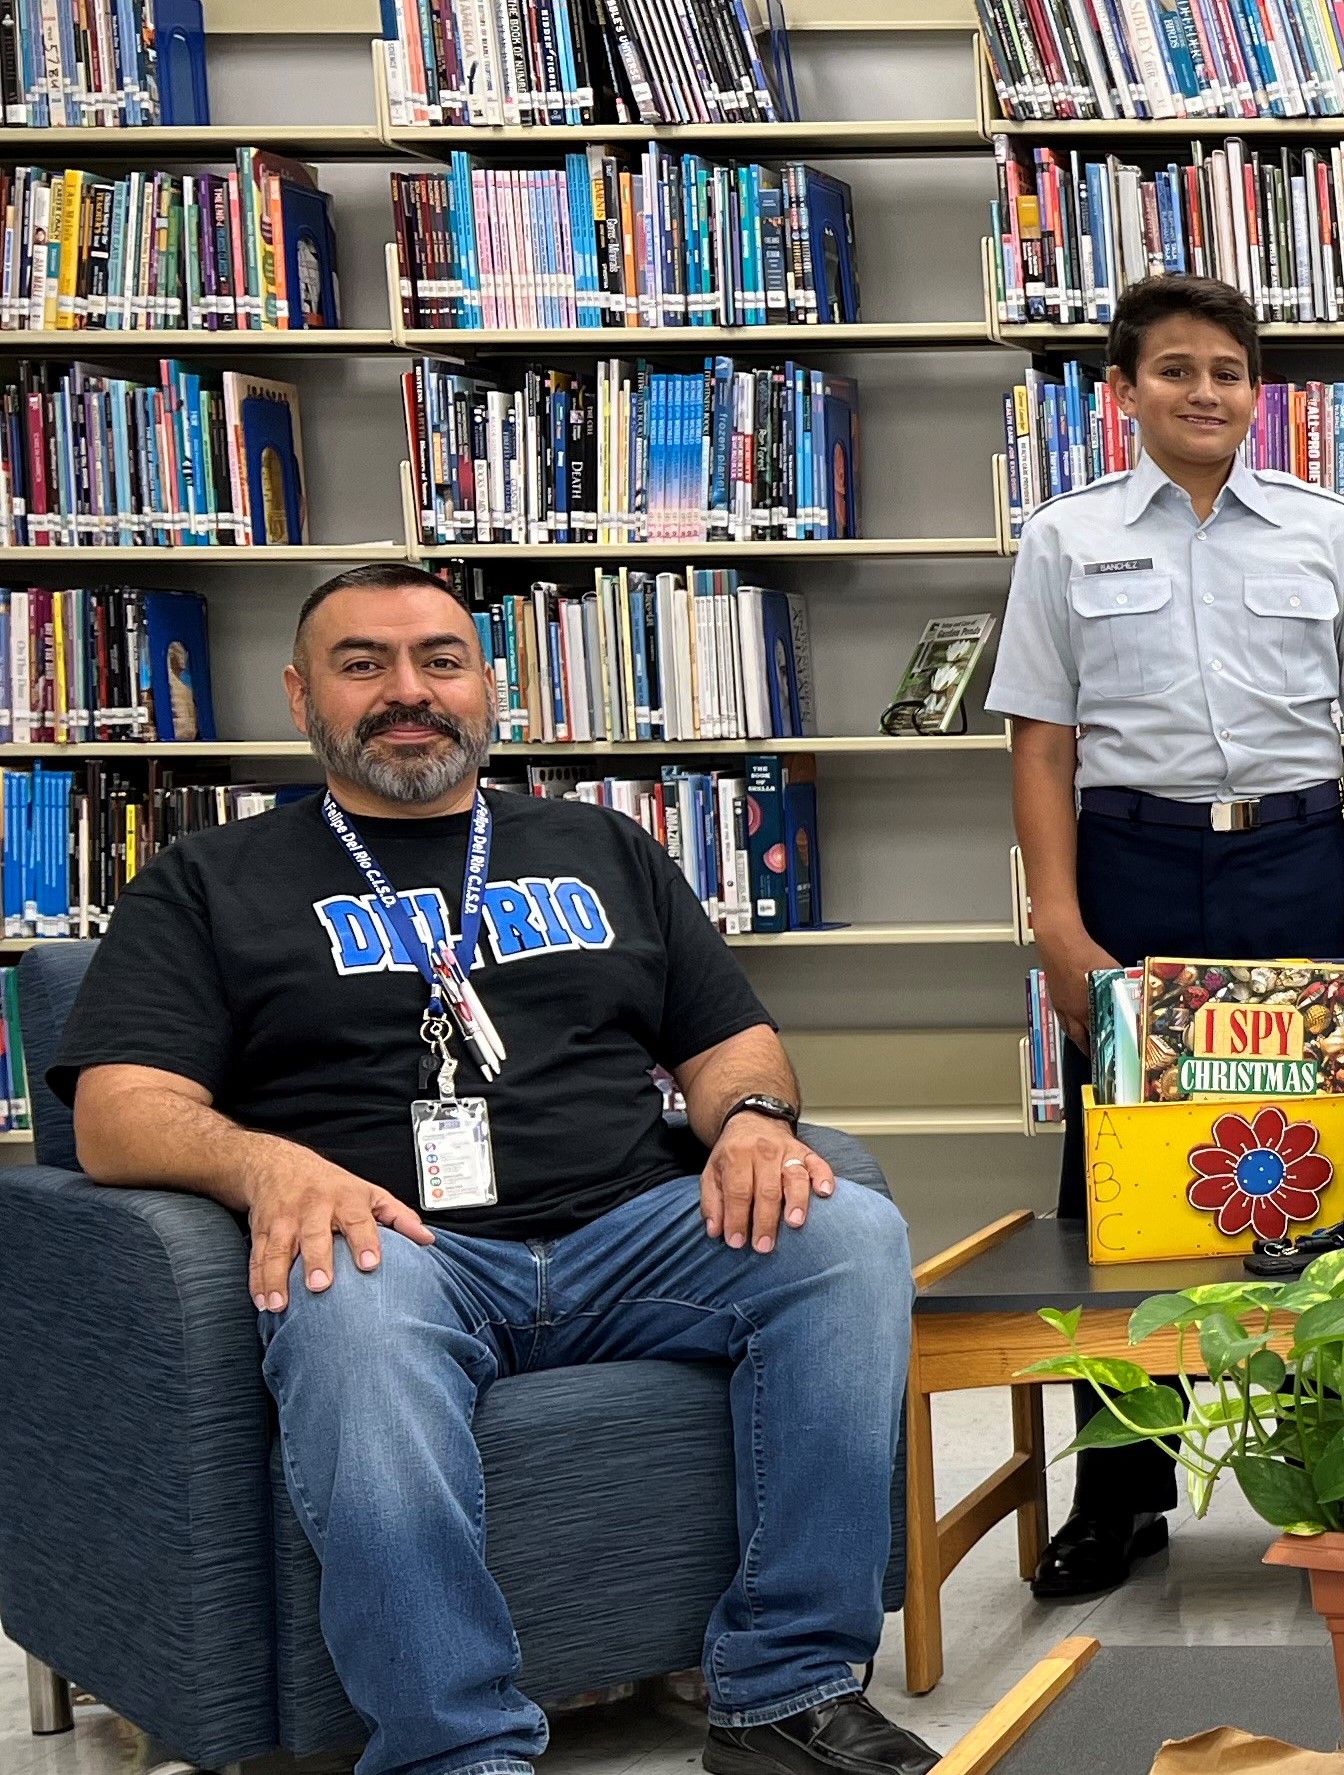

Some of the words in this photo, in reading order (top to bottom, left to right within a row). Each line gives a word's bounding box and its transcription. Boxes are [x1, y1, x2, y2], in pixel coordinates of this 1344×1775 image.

[460, 5, 477, 58] AMERICA
[509, 19, 522, 44] BOOK
[541, 9, 553, 49] HIDDEN
[1129, 2, 1156, 54] SIBLEY
[1164, 19, 1180, 49] BIRDS
[46, 45, 59, 64] 57
[513, 47, 522, 58] OF
[48, 69, 60, 89] BU
[545, 54, 557, 92] FIGURE
[66, 191, 75, 208] Am
[63, 210, 75, 241] Malala
[113, 213, 122, 234] AFTER
[1005, 399, 1013, 425] HEALTH
[716, 413, 729, 452] frozen
[1307, 406, 1320, 460] ALL-PRO
[716, 454, 729, 492] planet
[758, 446, 767, 471] Forest
[1049, 452, 1058, 486] Therapists
[1307, 462, 1320, 487] DIET
[571, 461, 583, 499] DEATH
[1100, 561, 1138, 572] SANCHEZ
[17, 641, 26, 655] On
[17, 658, 26, 675] This
[471, 834, 488, 853] Del
[665, 807, 679, 858] AMAZING
[325, 801, 348, 834] Felipe
[341, 832, 363, 852] Del
[352, 851, 372, 869] Rio
[365, 869, 397, 909] C.I.S.D.
[469, 853, 486, 874] Rio
[464, 875, 483, 914] C.I.S.D.
[485, 876, 616, 965] RIO
[1203, 1009, 1216, 1055] I
[1229, 1008, 1296, 1057] SPY
[1180, 1059, 1316, 1094] CHRISTMAS
[1095, 1110, 1123, 1151] A
[1093, 1161, 1122, 1203] B
[1096, 1212, 1126, 1251] C
